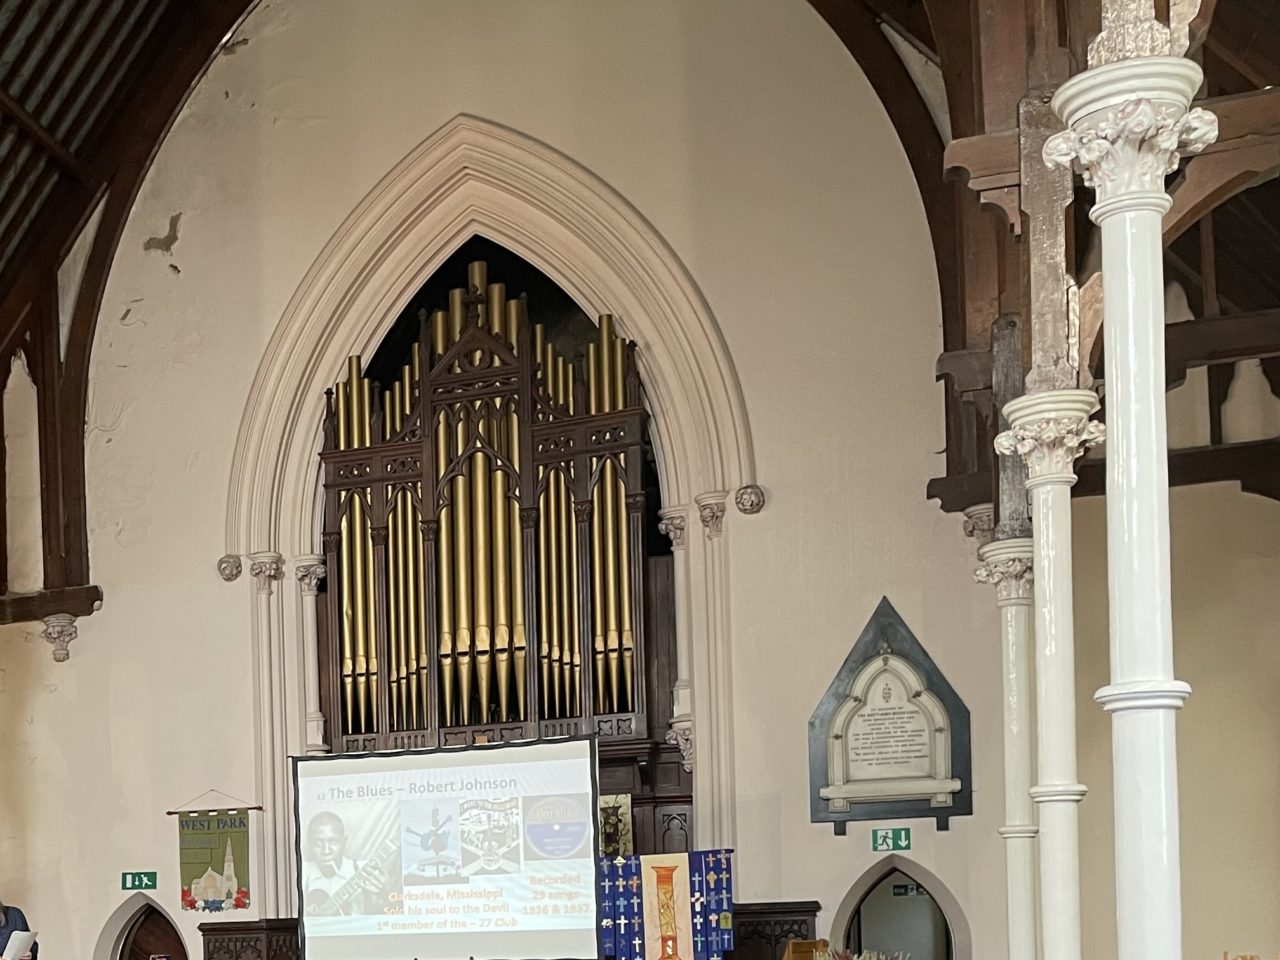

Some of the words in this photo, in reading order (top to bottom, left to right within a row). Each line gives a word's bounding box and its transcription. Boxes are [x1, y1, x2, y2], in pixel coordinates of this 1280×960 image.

[329, 787, 353, 799] The
[357, 785, 393, 798] Blues
[409, 781, 456, 795] Robert
[459, 777, 517, 792] Johnson
[180, 819, 213, 831] WEST
[216, 817, 247, 829] PARK
[529, 874, 581, 885] Recorded
[388, 891, 444, 902] Clarksdale,
[446, 889, 504, 901] Mississippi
[532, 890, 545, 900] 29
[548, 890, 579, 902] songs
[408, 905, 423, 916] his
[424, 905, 447, 915] soul
[448, 905, 461, 914] to
[463, 904, 481, 914] the
[483, 903, 510, 913] Devil
[391, 920, 434, 931] member
[436, 919, 448, 929] of
[450, 918, 467, 929] the
[479, 919, 492, 928] 27
[494, 918, 517, 928] Club
